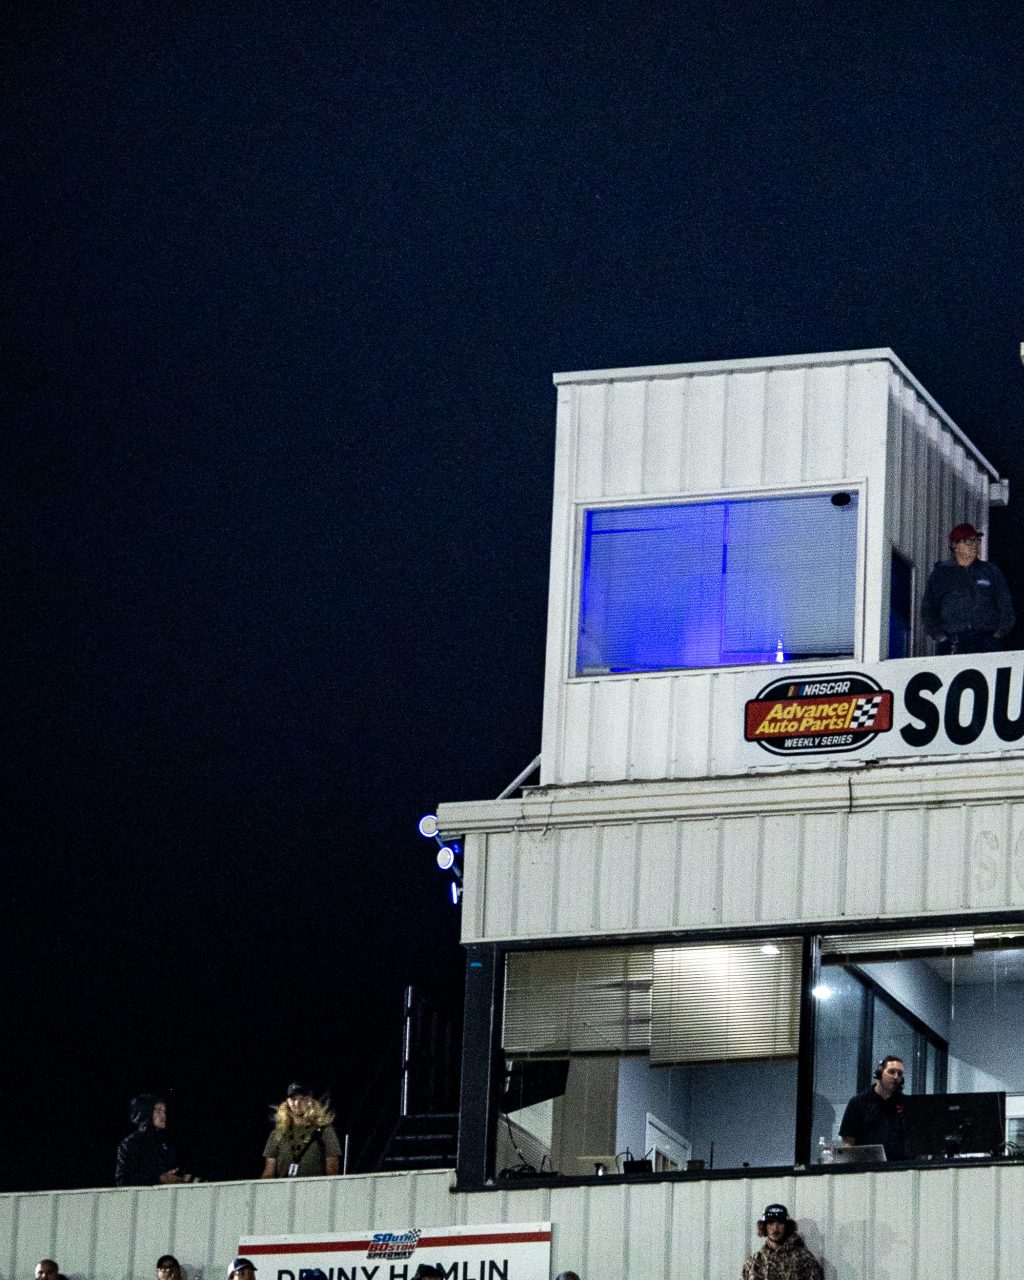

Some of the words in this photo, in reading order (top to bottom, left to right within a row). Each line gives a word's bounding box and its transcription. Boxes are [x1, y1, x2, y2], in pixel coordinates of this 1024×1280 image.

[803, 681, 850, 696] NASCAR
[765, 702, 849, 721] Advance
[755, 719, 800, 735] Auto
[799, 715, 846, 732] Parts
[784, 736, 820, 748] WEEKLY
[820, 734, 853, 746] SERIES
